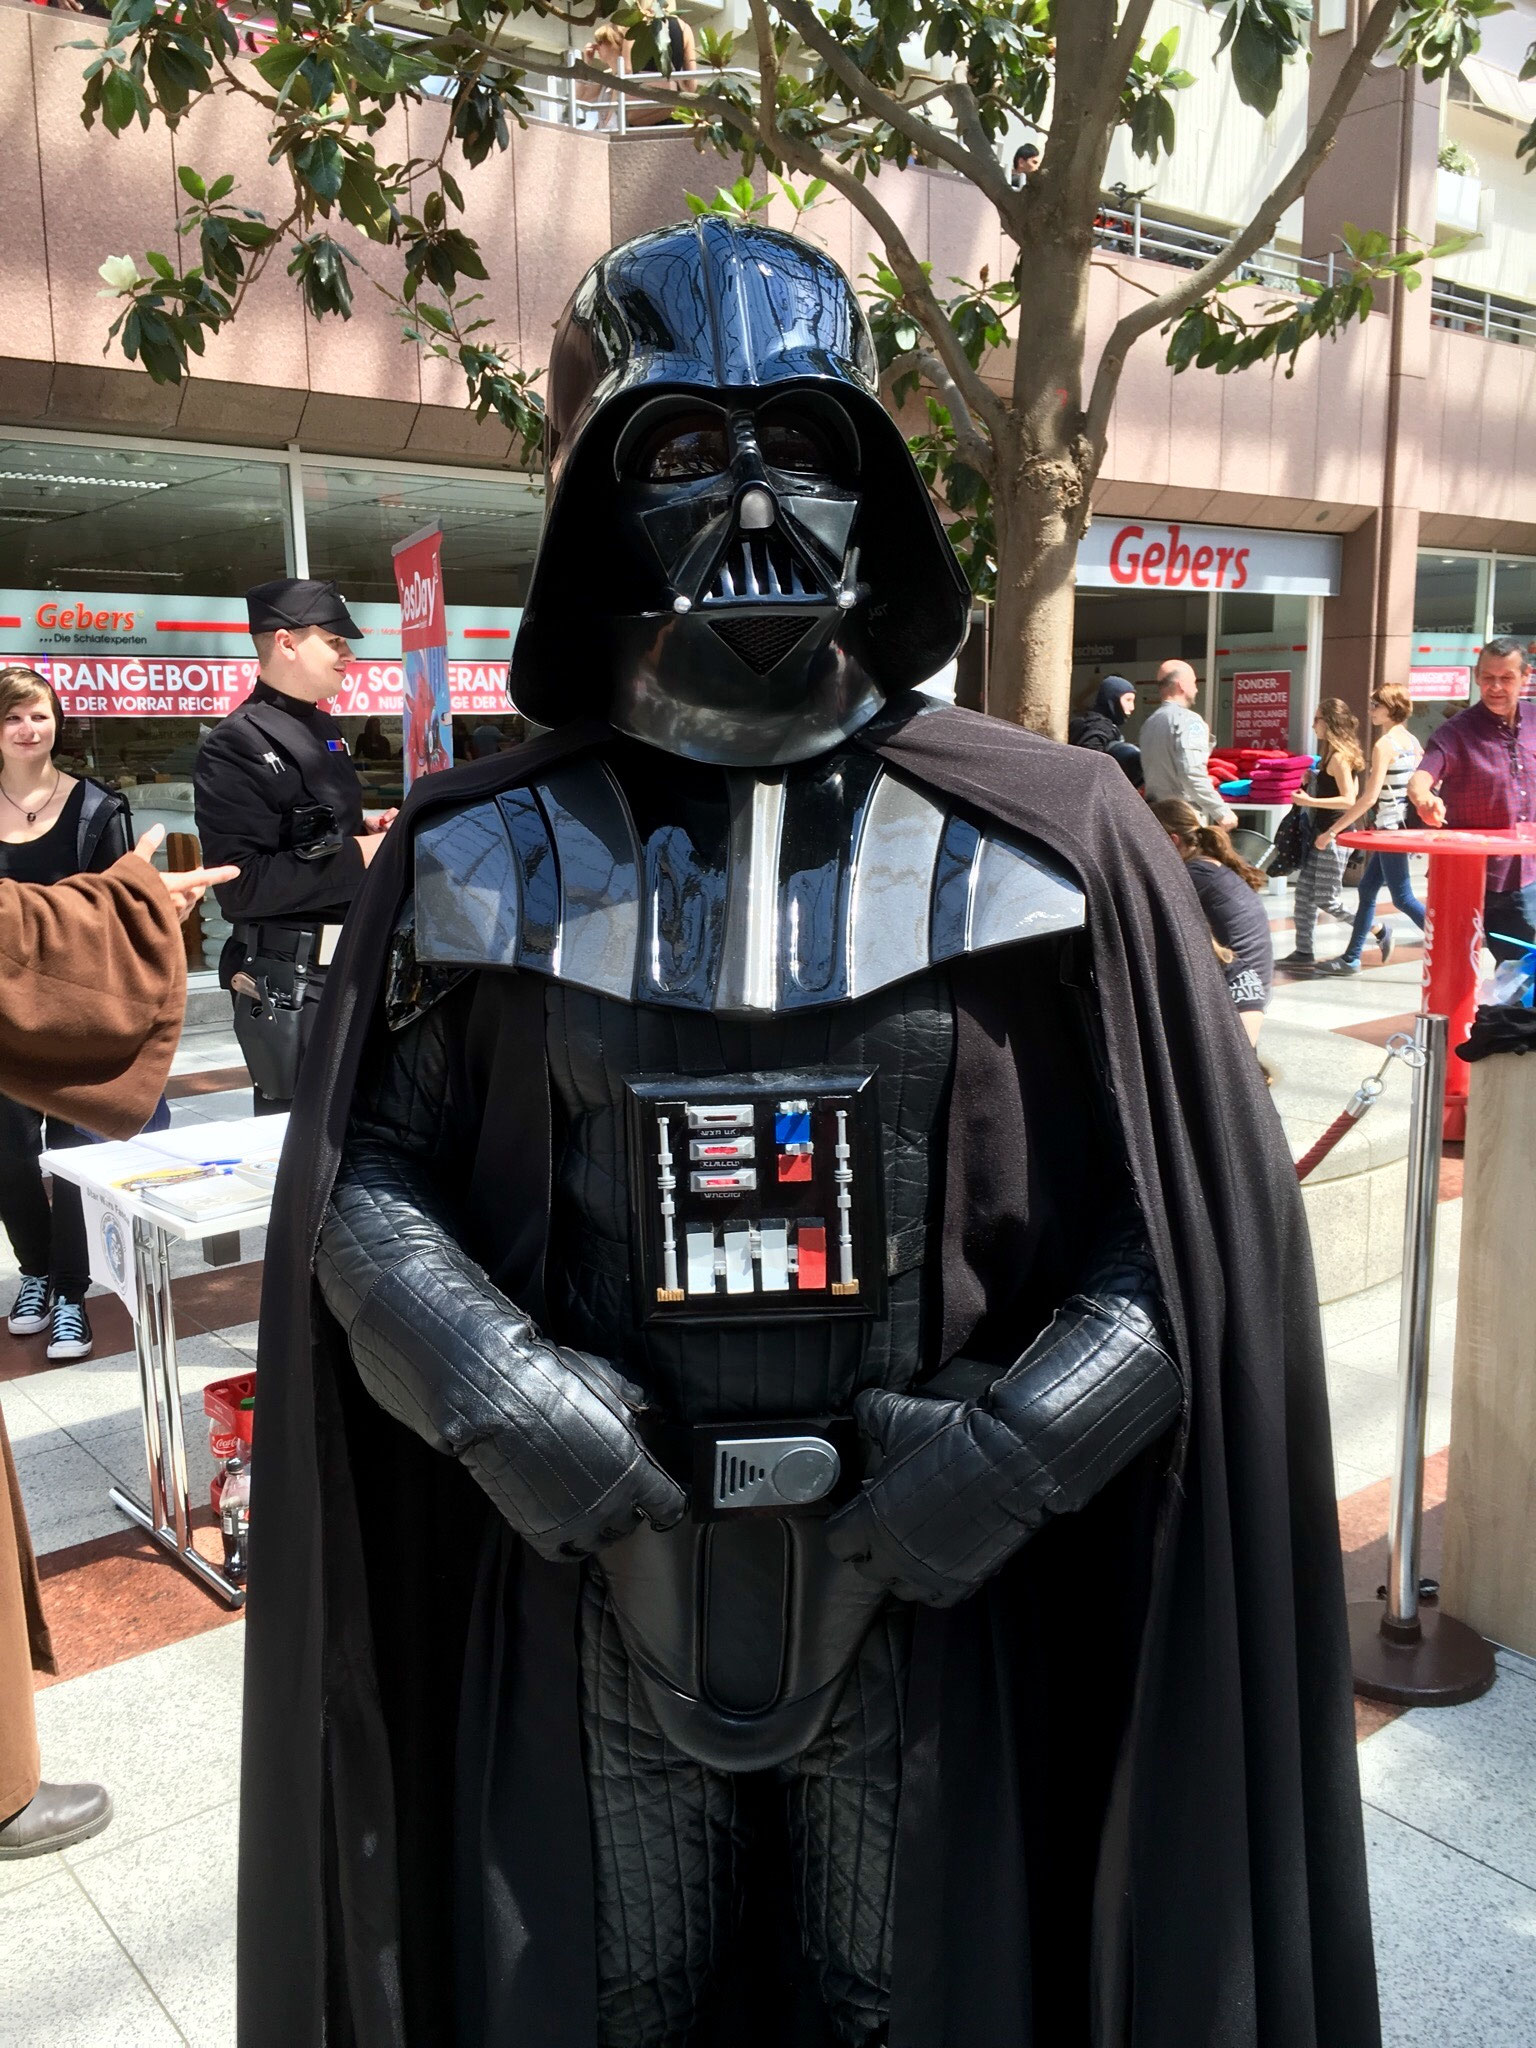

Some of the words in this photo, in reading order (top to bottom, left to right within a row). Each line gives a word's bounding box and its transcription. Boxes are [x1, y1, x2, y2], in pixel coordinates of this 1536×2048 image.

[1109, 524, 1250, 590] Gebers
[36, 602, 135, 632] Gebers
[74, 634, 147, 645] Schlafexperten
[0, 662, 239, 692] ERANGEBOTE
[1237, 678, 1280, 690] SONDER-
[76, 697, 108, 711] DER
[111, 697, 173, 711] VORRAT
[178, 697, 231, 711] REICHT
[473, 696, 496, 709] DER
[1237, 692, 1288, 704] ANGEBOTE
[1253, 709, 1288, 719] SOLANGE
